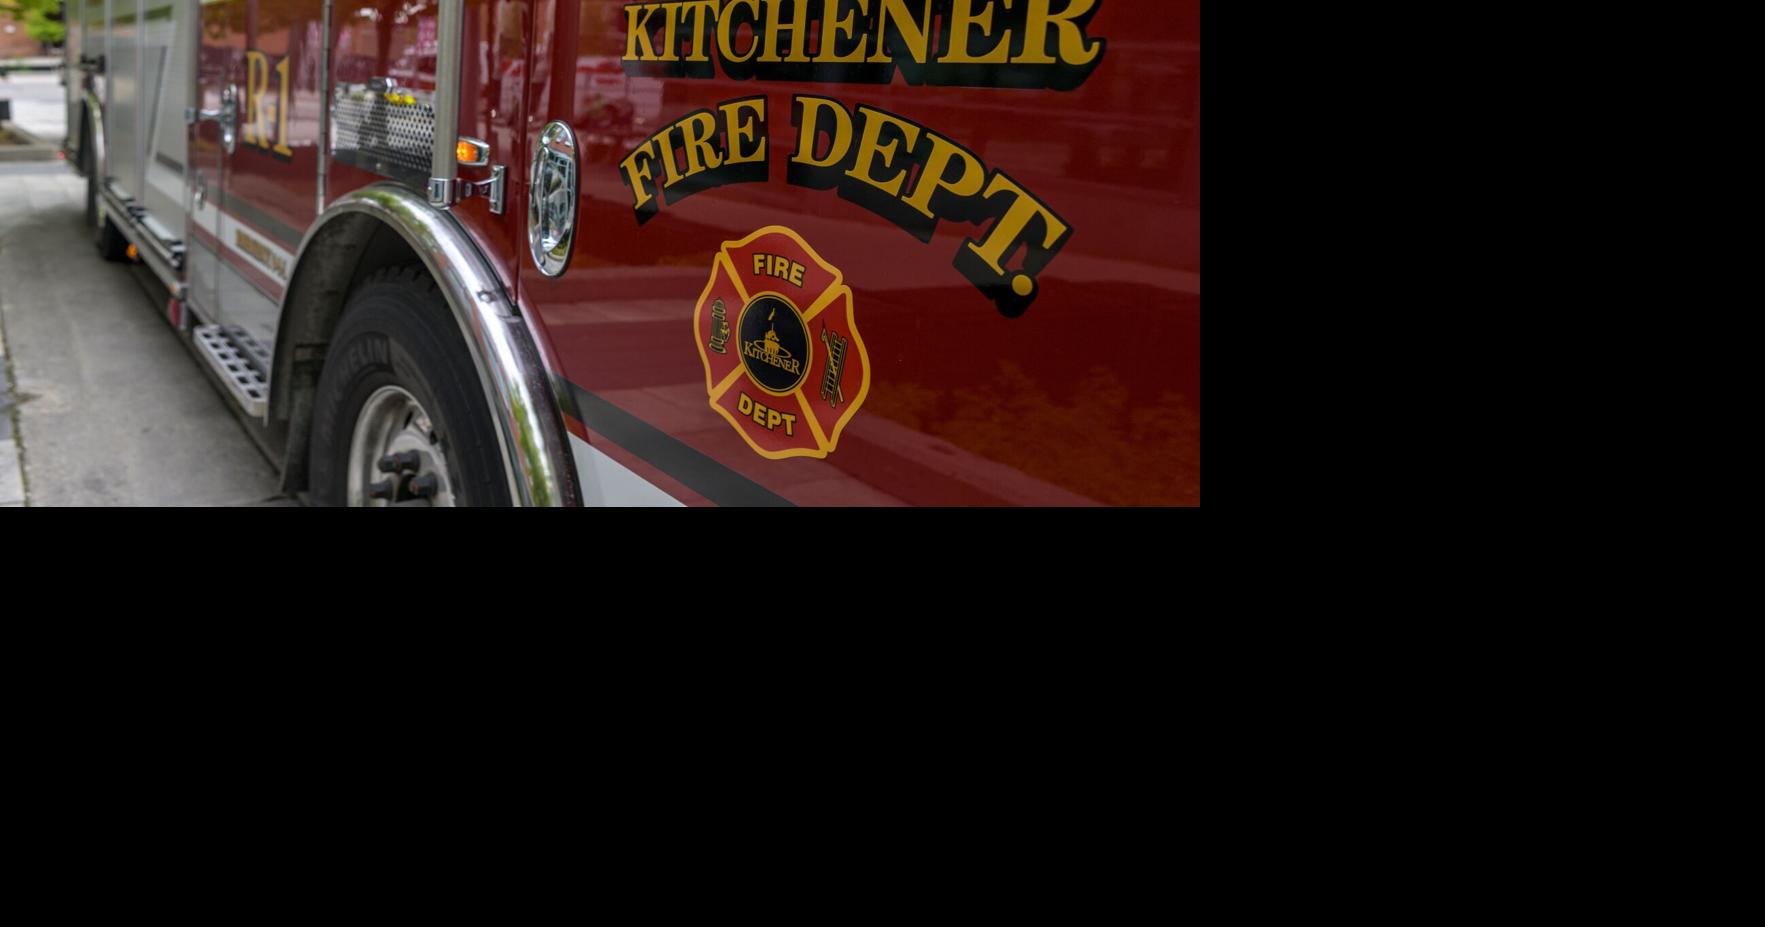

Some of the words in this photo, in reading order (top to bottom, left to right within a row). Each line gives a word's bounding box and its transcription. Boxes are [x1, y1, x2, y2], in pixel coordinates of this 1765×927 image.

[620, 0, 1103, 67] KITCHENER
[618, 98, 768, 212] FIRE
[790, 95, 1071, 298] DEPT.
[752, 253, 806, 288] FIRE
[743, 340, 801, 376] KITCHENER
[737, 391, 797, 436] DEPT
